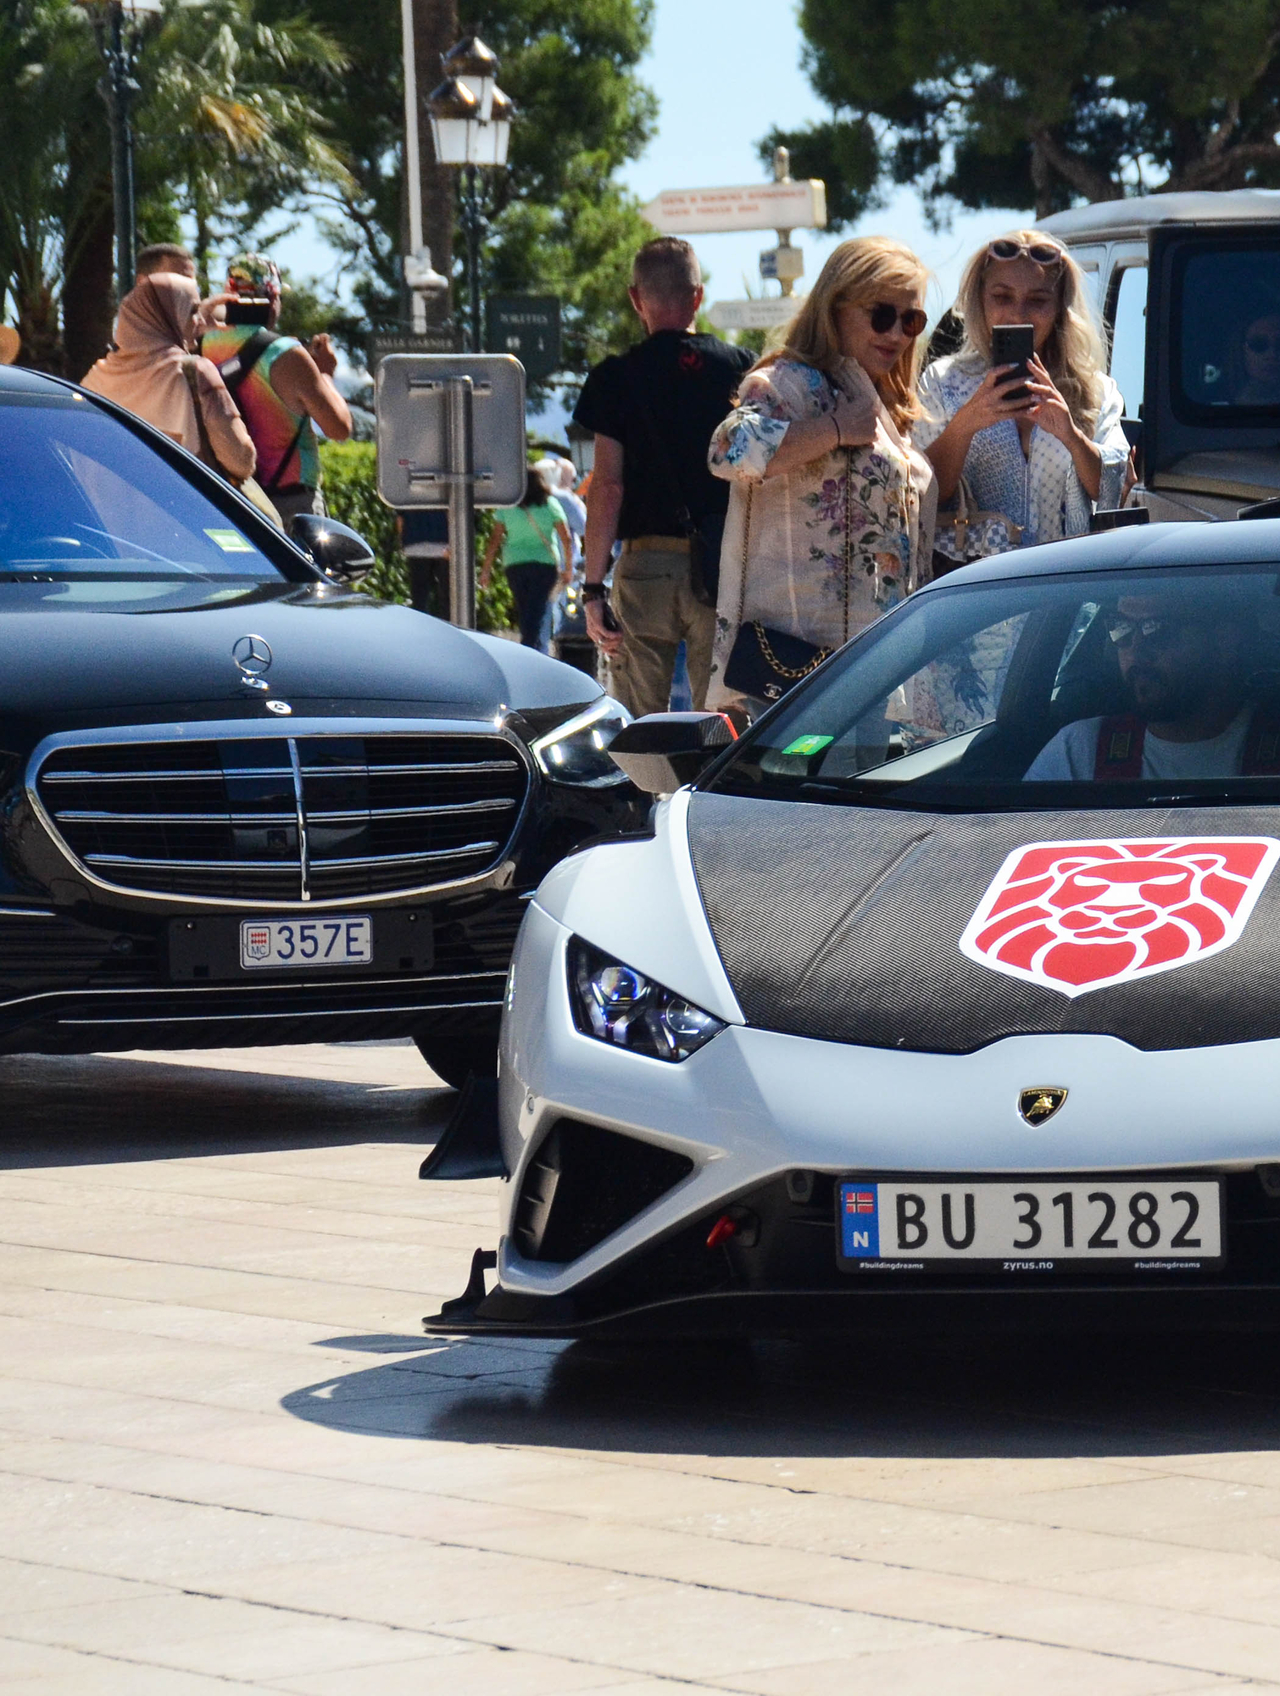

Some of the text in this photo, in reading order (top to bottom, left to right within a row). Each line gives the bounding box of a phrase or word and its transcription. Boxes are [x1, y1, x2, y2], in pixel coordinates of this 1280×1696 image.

[276, 922, 365, 960] 357E
[251, 945, 267, 956] MC
[896, 1191, 1202, 1250] BU 31282
[853, 1231, 869, 1248] N
[859, 1261, 924, 1271] #buildingdreams
[1003, 1261, 1054, 1271] zyrus.no
[1134, 1260, 1201, 1270] #buildingdreams
